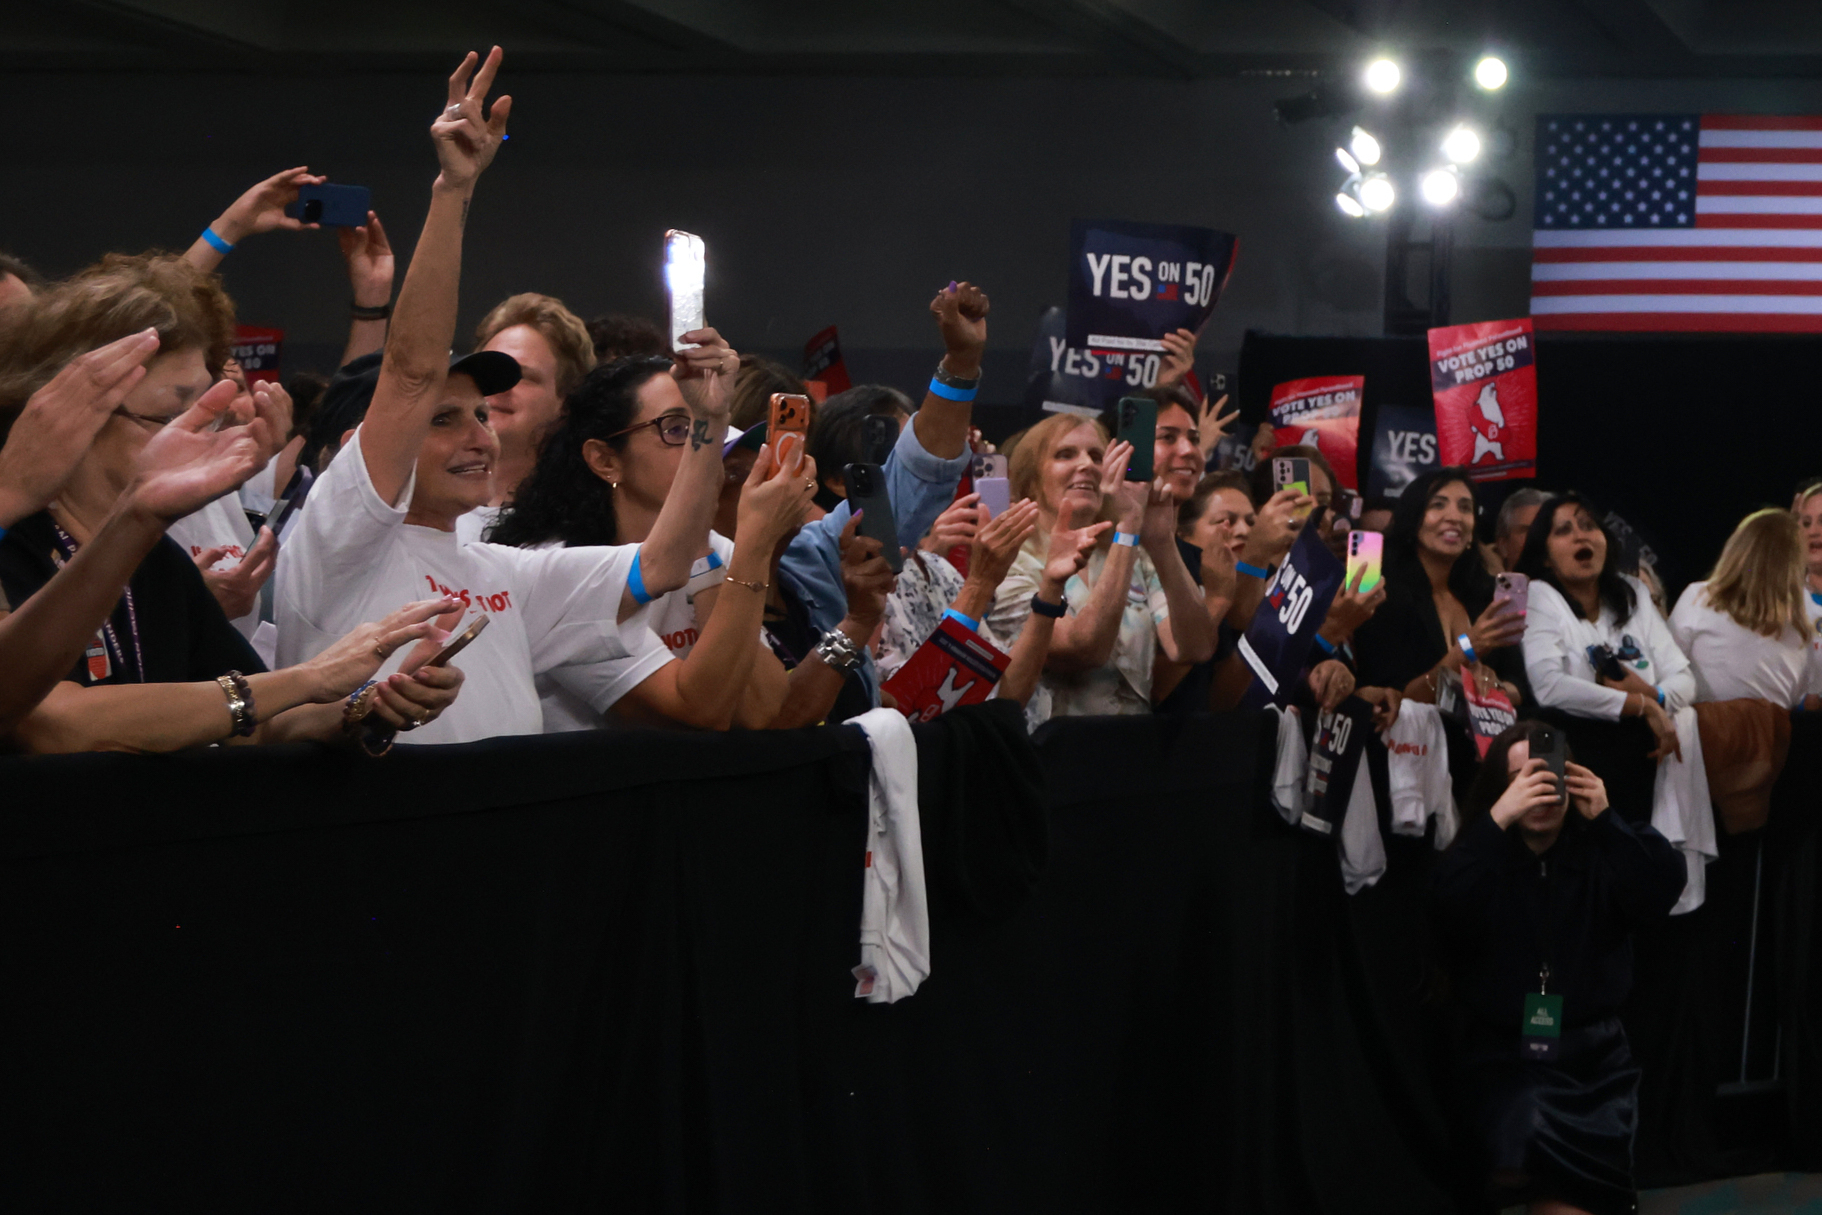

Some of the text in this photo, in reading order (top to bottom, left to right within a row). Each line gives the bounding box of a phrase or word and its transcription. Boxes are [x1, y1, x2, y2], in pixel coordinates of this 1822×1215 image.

[1086, 252, 1215, 307] YES ON 50
[256, 343, 276, 356] ON
[1050, 337, 1100, 378] YES
[1126, 354, 1160, 388] 50
[1437, 335, 1528, 373] VOTE YES ON
[1454, 355, 1515, 384] PROP 50
[1272, 399, 1305, 417] VOTE
[1308, 393, 1332, 408] YES
[1334, 389, 1355, 404] ON
[1388, 430, 1436, 464] YES
[1278, 574, 1313, 635] 50
[1328, 712, 1353, 756] 50
